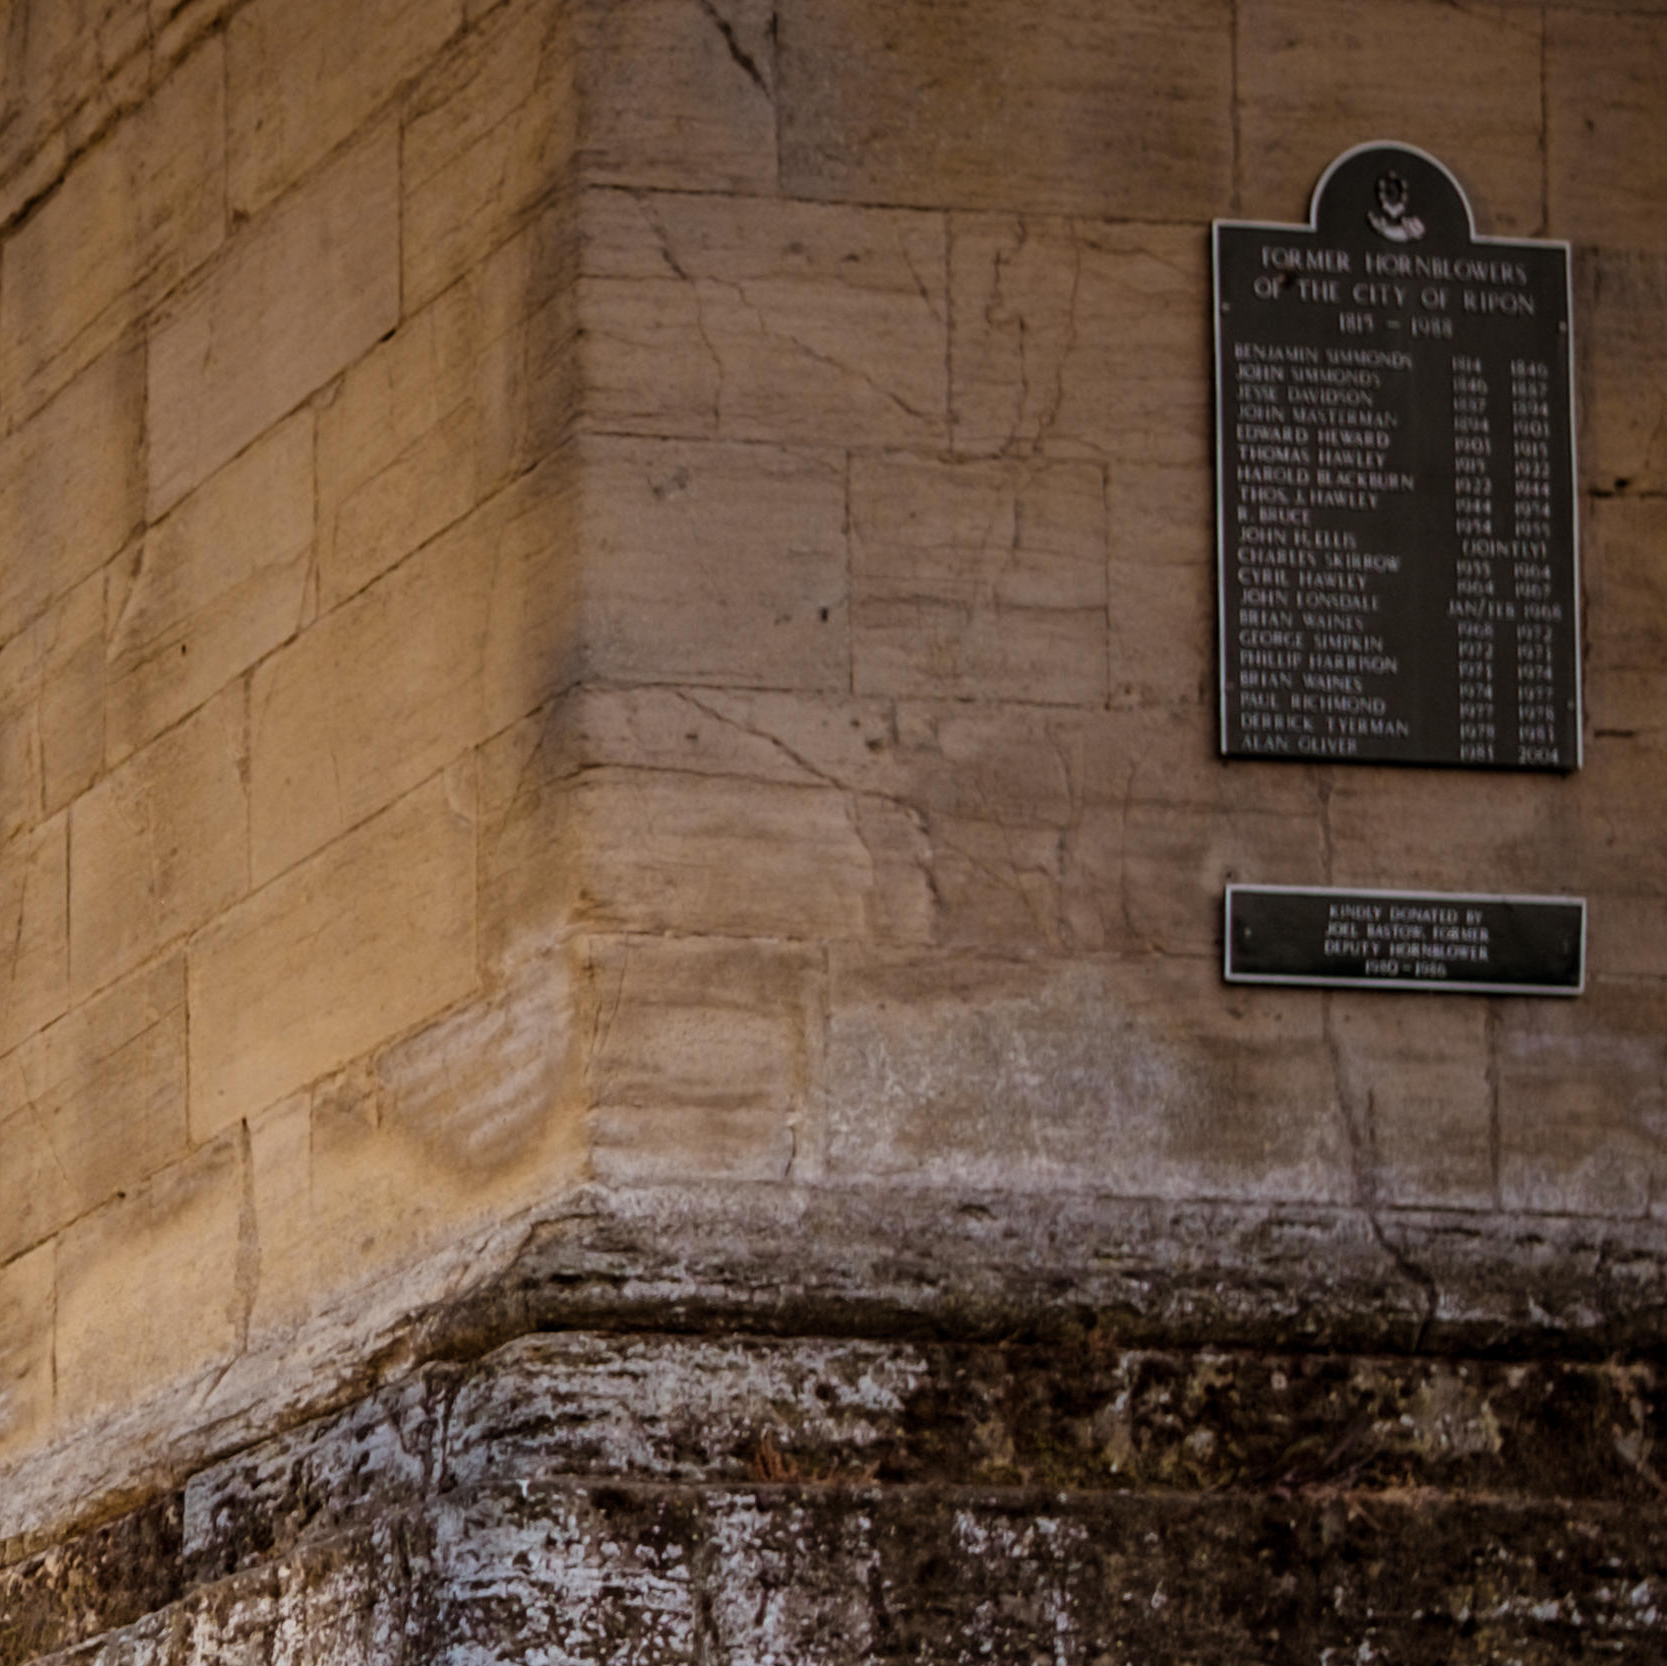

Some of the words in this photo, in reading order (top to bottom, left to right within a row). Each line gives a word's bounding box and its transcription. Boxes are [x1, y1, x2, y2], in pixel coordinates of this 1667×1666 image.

[1261, 246, 1350, 272] FORMER
[1364, 252, 1526, 284] HORNBLOWERS
[1252, 275, 1281, 299] OF
[1297, 278, 1339, 303] THE
[1352, 282, 1404, 306] CITY
[1420, 286, 1447, 310] OF
[1463, 289, 1535, 315] RIPON
[1410, 316, 1453, 338] 1988
[1234, 342, 1317, 364] BENJAMIN
[1324, 347, 1413, 370] SIMMONDS
[1236, 362, 1283, 383] JOHN
[1290, 366, 1380, 388] SIMMONDS
[1287, 386, 1373, 407] DAVIDSON
[1237, 403, 1284, 423] JOHN
[1236, 423, 1308, 445] EDWARD
[1239, 444, 1309, 464] THOMAS
[1318, 448, 1385, 469] HAWLEY
[1236, 463, 1309, 486] HAROLD
[1317, 468, 1413, 492] BLACKBURN
[1309, 488, 1378, 509] HAWLEY
[1258, 505, 1308, 524] BRUCE
[1239, 524, 1286, 545] JOHN
[1314, 529, 1356, 549] ELLIS
[1237, 547, 1315, 568] CHARLES
[1324, 552, 1400, 573] SKIRROW
[1237, 566, 1288, 587] CYRIL
[1298, 570, 1365, 590] HAWLEY
[1239, 587, 1287, 607] JOHN
[1296, 590, 1377, 611] LONSDALE
[1239, 609, 1291, 628] BRIAN
[1239, 628, 1303, 649] GEORGE
[1314, 632, 1383, 653] SIMPKIN
[1239, 649, 1301, 669] PHILLIP
[1308, 652, 1397, 675] HARRISON
[1239, 669, 1291, 689] BRIAN
[1239, 691, 1279, 709] PAUL
[1290, 693, 1385, 716] RICHMOND
[1240, 712, 1313, 733] DERRICK
[1327, 717, 1408, 737] TYERMAN
[1241, 733, 1289, 752] ALAN
[1297, 735, 1357, 756] OLIVER
[1329, 903, 1380, 920] KINDLY
[1389, 905, 1458, 923] DONATED
[1466, 909, 1481, 924] BY
[1432, 925, 1488, 943] FORMER
[1324, 939, 1379, 957] DEPUTY
[1389, 942, 1488, 961] HORNBLOWER
